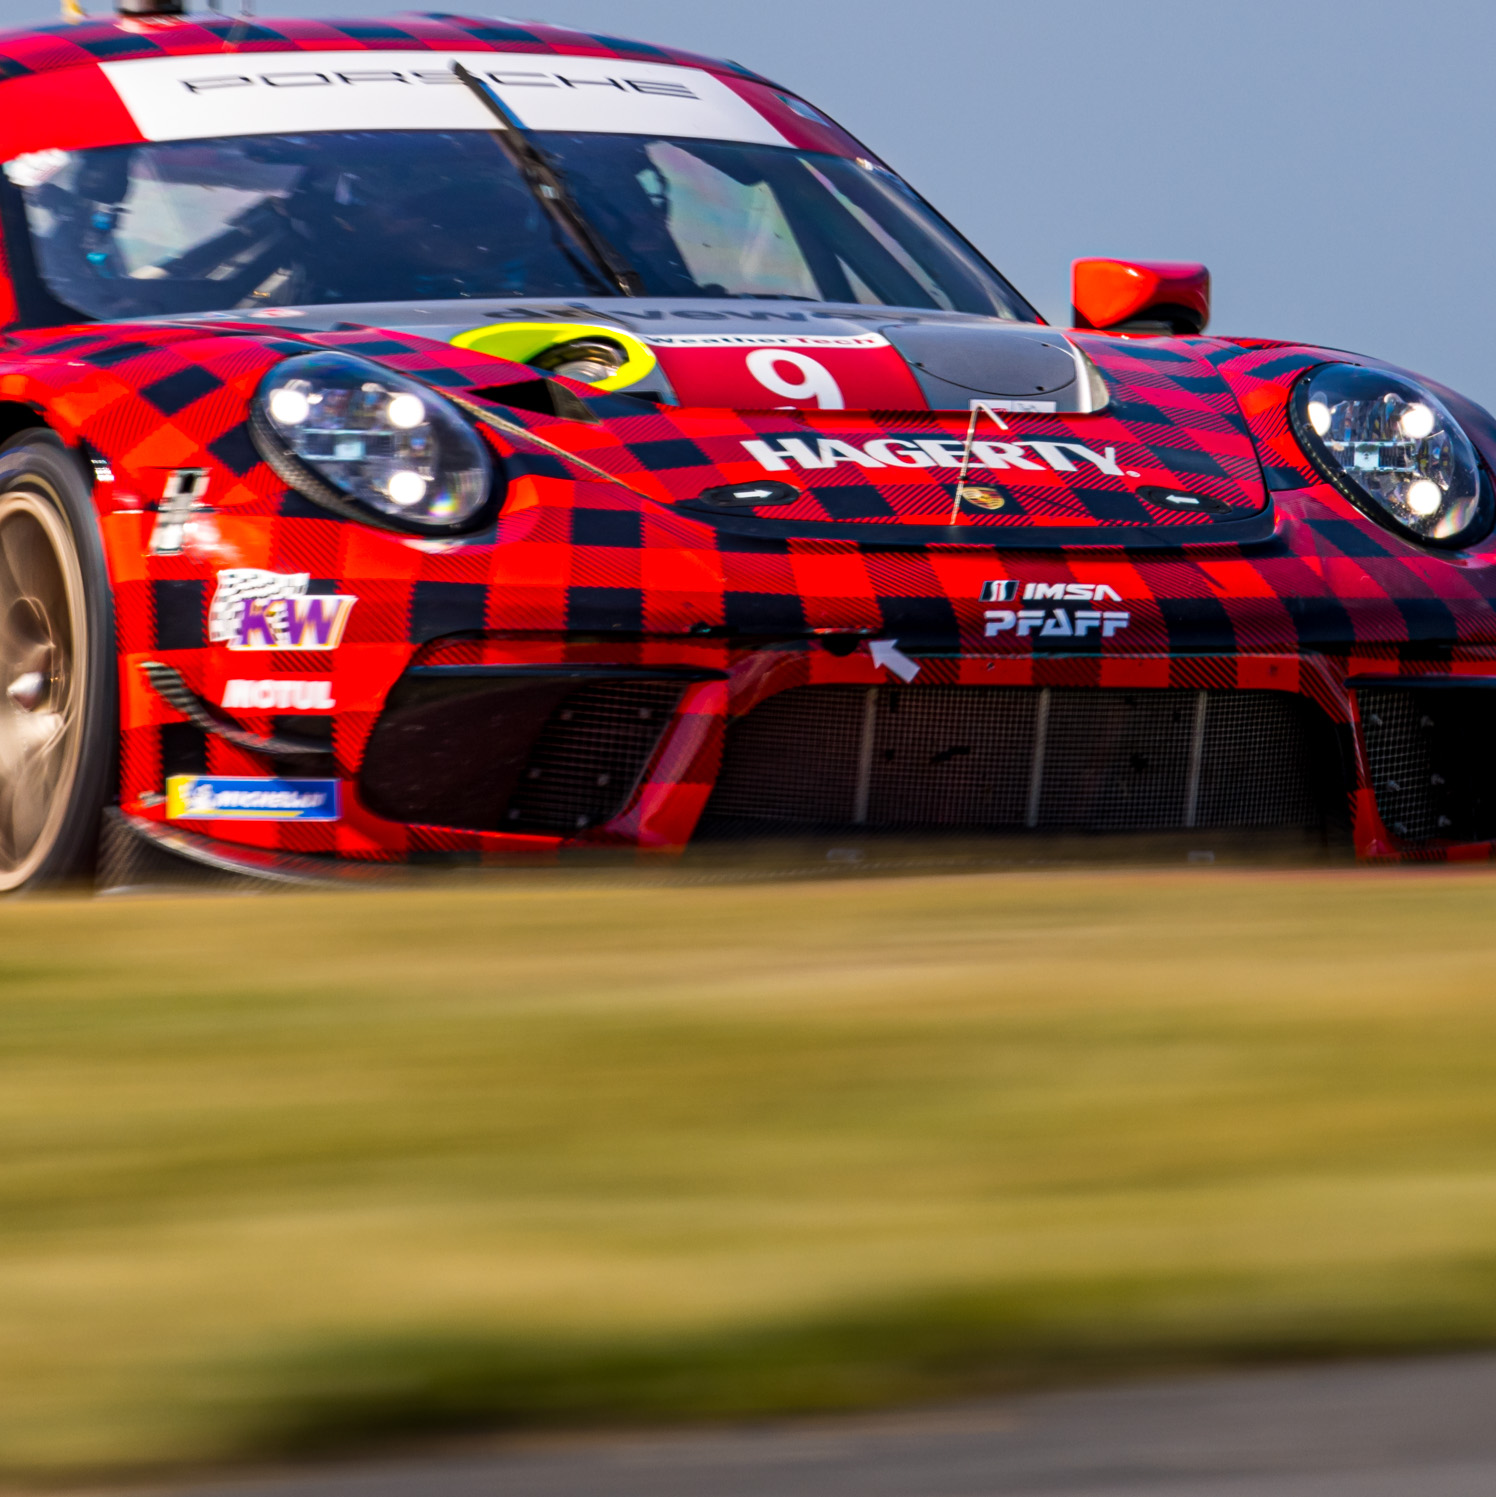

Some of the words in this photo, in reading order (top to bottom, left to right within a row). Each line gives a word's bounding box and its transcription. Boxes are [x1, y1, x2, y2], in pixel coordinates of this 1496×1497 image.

[180, 68, 701, 100] PORSCHE
[645, 335, 875, 346] WeatherTech
[745, 348, 845, 410] 9
[740, 438, 1125, 476] HAGERTY
[1022, 582, 1123, 602] IMSA
[240, 597, 345, 647] KW
[983, 608, 1131, 638] PFAFF
[220, 678, 336, 710] MOTUL
